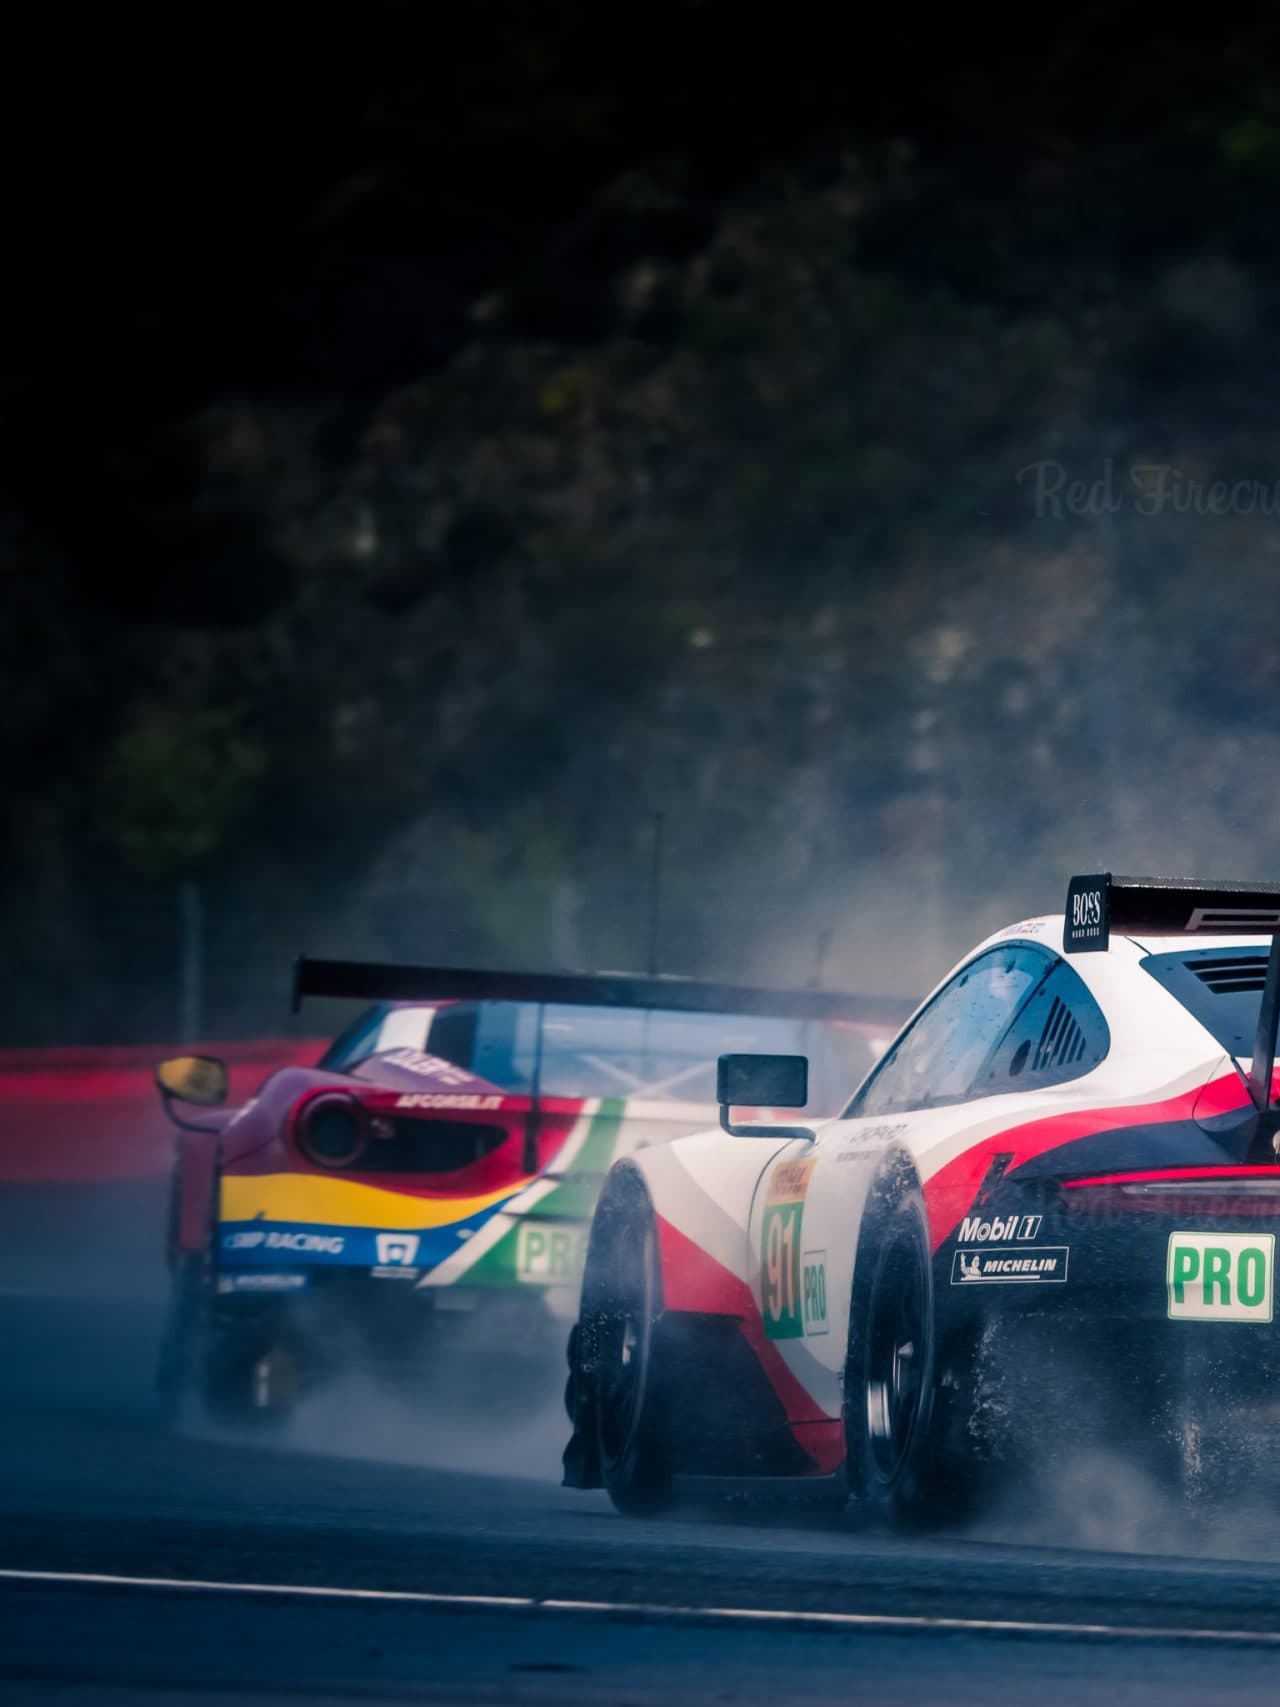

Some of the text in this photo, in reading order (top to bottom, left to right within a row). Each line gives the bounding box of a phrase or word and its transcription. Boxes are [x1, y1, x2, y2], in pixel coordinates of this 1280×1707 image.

[1073, 891, 1101, 926] BOSS
[957, 1216, 1019, 1243] Mobil
[524, 1230, 588, 1274] PR
[767, 1210, 796, 1322] 91
[983, 1258, 1057, 1273] MICHELIN
[804, 1263, 826, 1321] PRO
[1174, 1246, 1266, 1307] PRO
